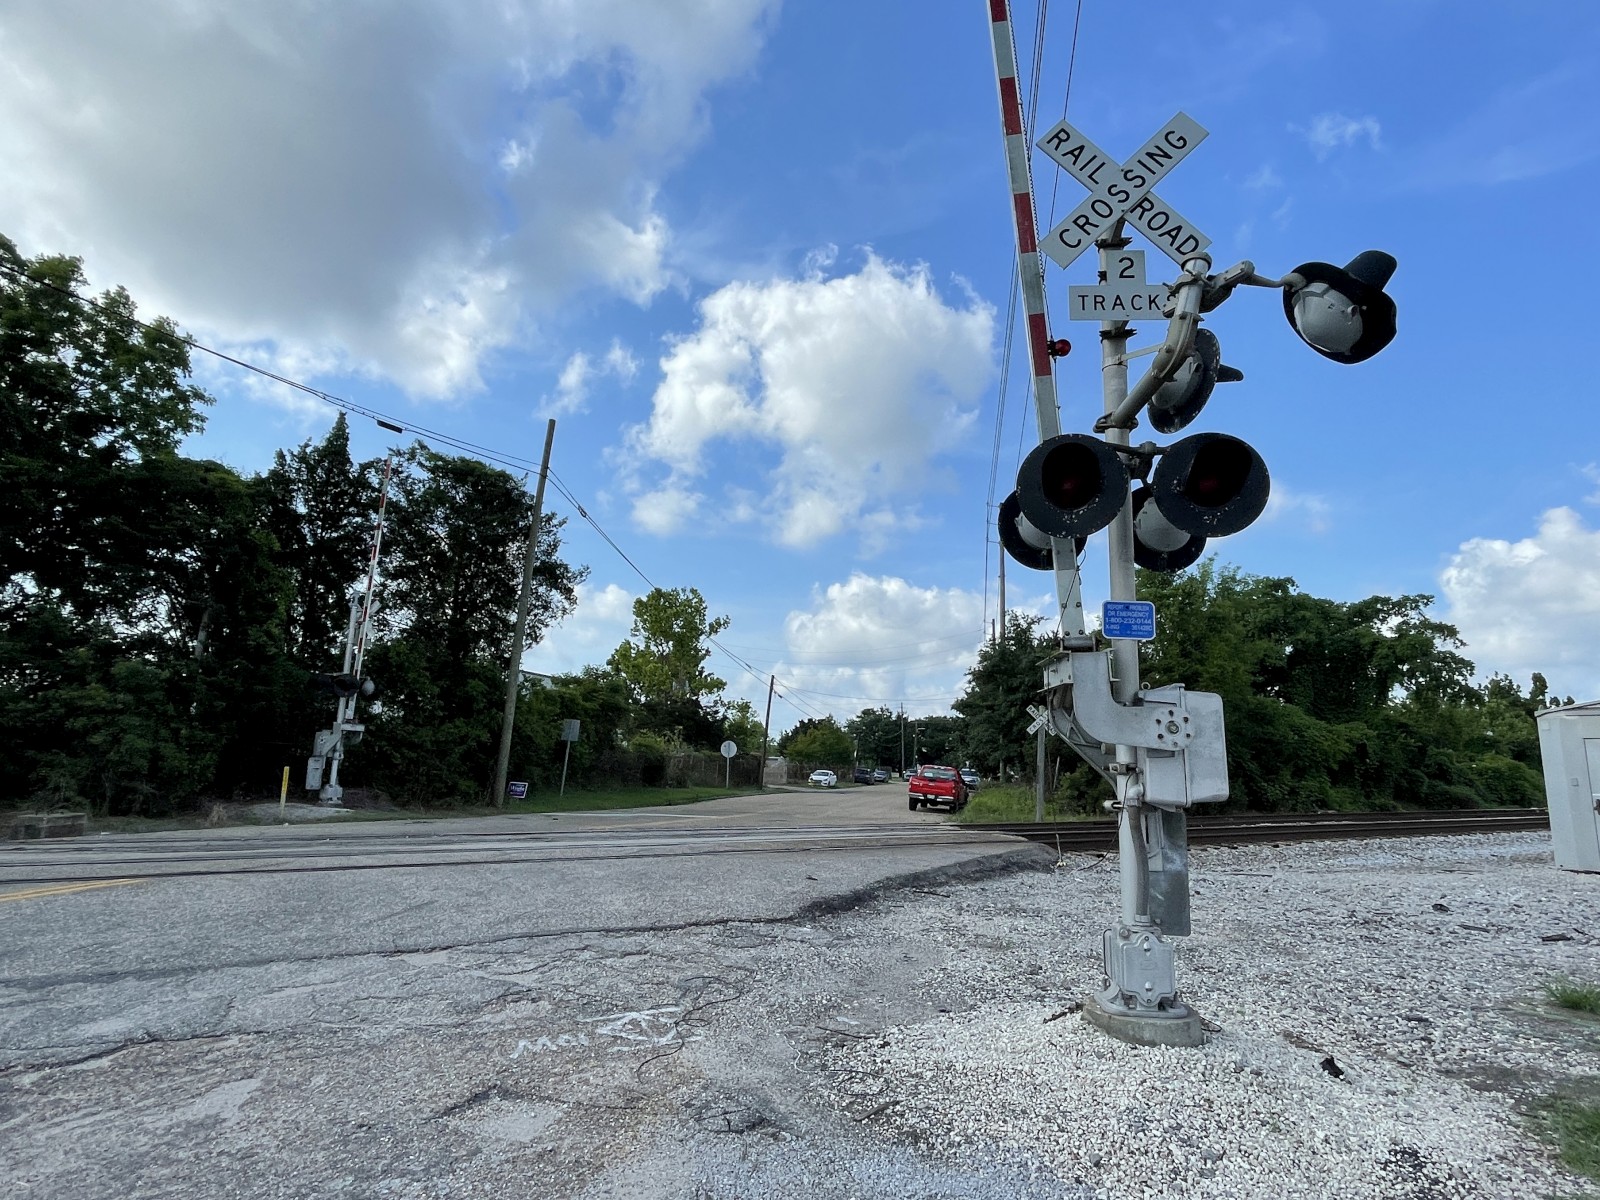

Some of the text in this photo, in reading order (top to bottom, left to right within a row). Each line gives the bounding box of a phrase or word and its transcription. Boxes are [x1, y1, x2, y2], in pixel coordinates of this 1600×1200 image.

[1046, 127, 1106, 185] RAIL
[1058, 130, 1188, 249] CROSSING
[1129, 196, 1200, 256] ROAD
[1118, 256, 1135, 279] 2
[1028, 707, 1040, 719] RAIL
